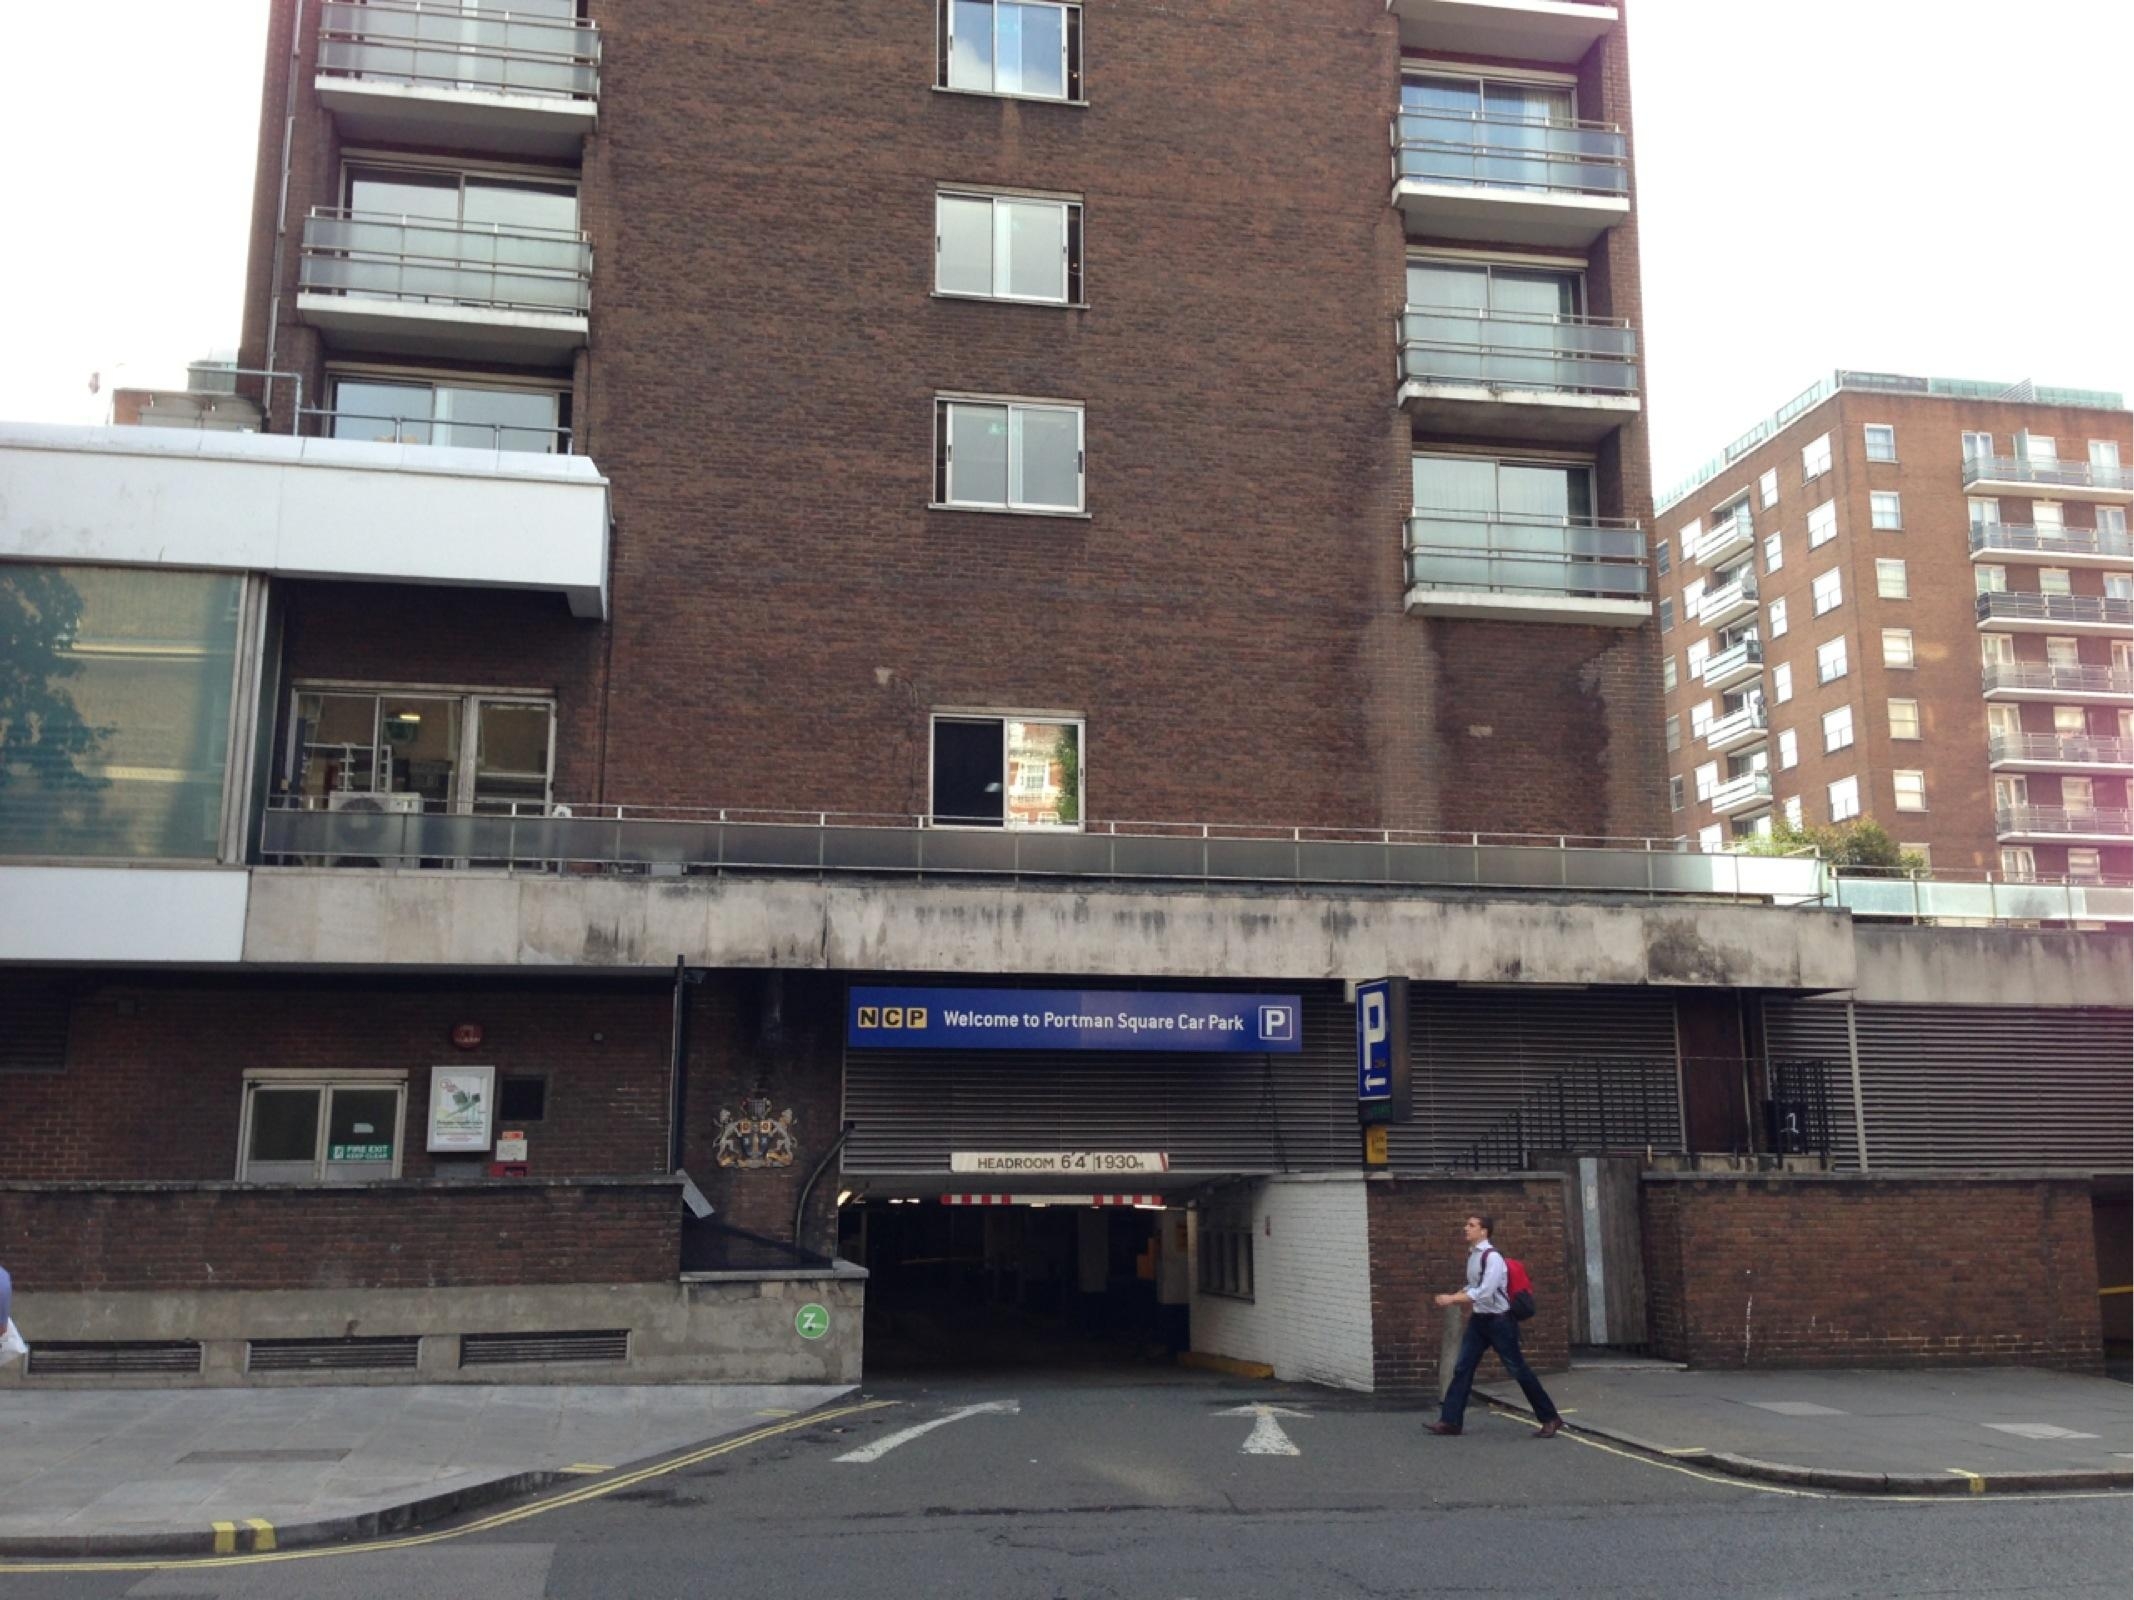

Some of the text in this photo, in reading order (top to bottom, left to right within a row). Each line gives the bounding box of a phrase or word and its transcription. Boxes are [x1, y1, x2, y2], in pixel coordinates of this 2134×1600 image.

[859, 1008, 926, 1027] NCP
[943, 1010, 1245, 1034] Welcome to Portman Square Car Park
[1265, 1009, 1286, 1036] P
[1363, 991, 1385, 1070] P
[368, 1144, 388, 1153] EXIT
[977, 1156, 1054, 1169] HEADROOM
